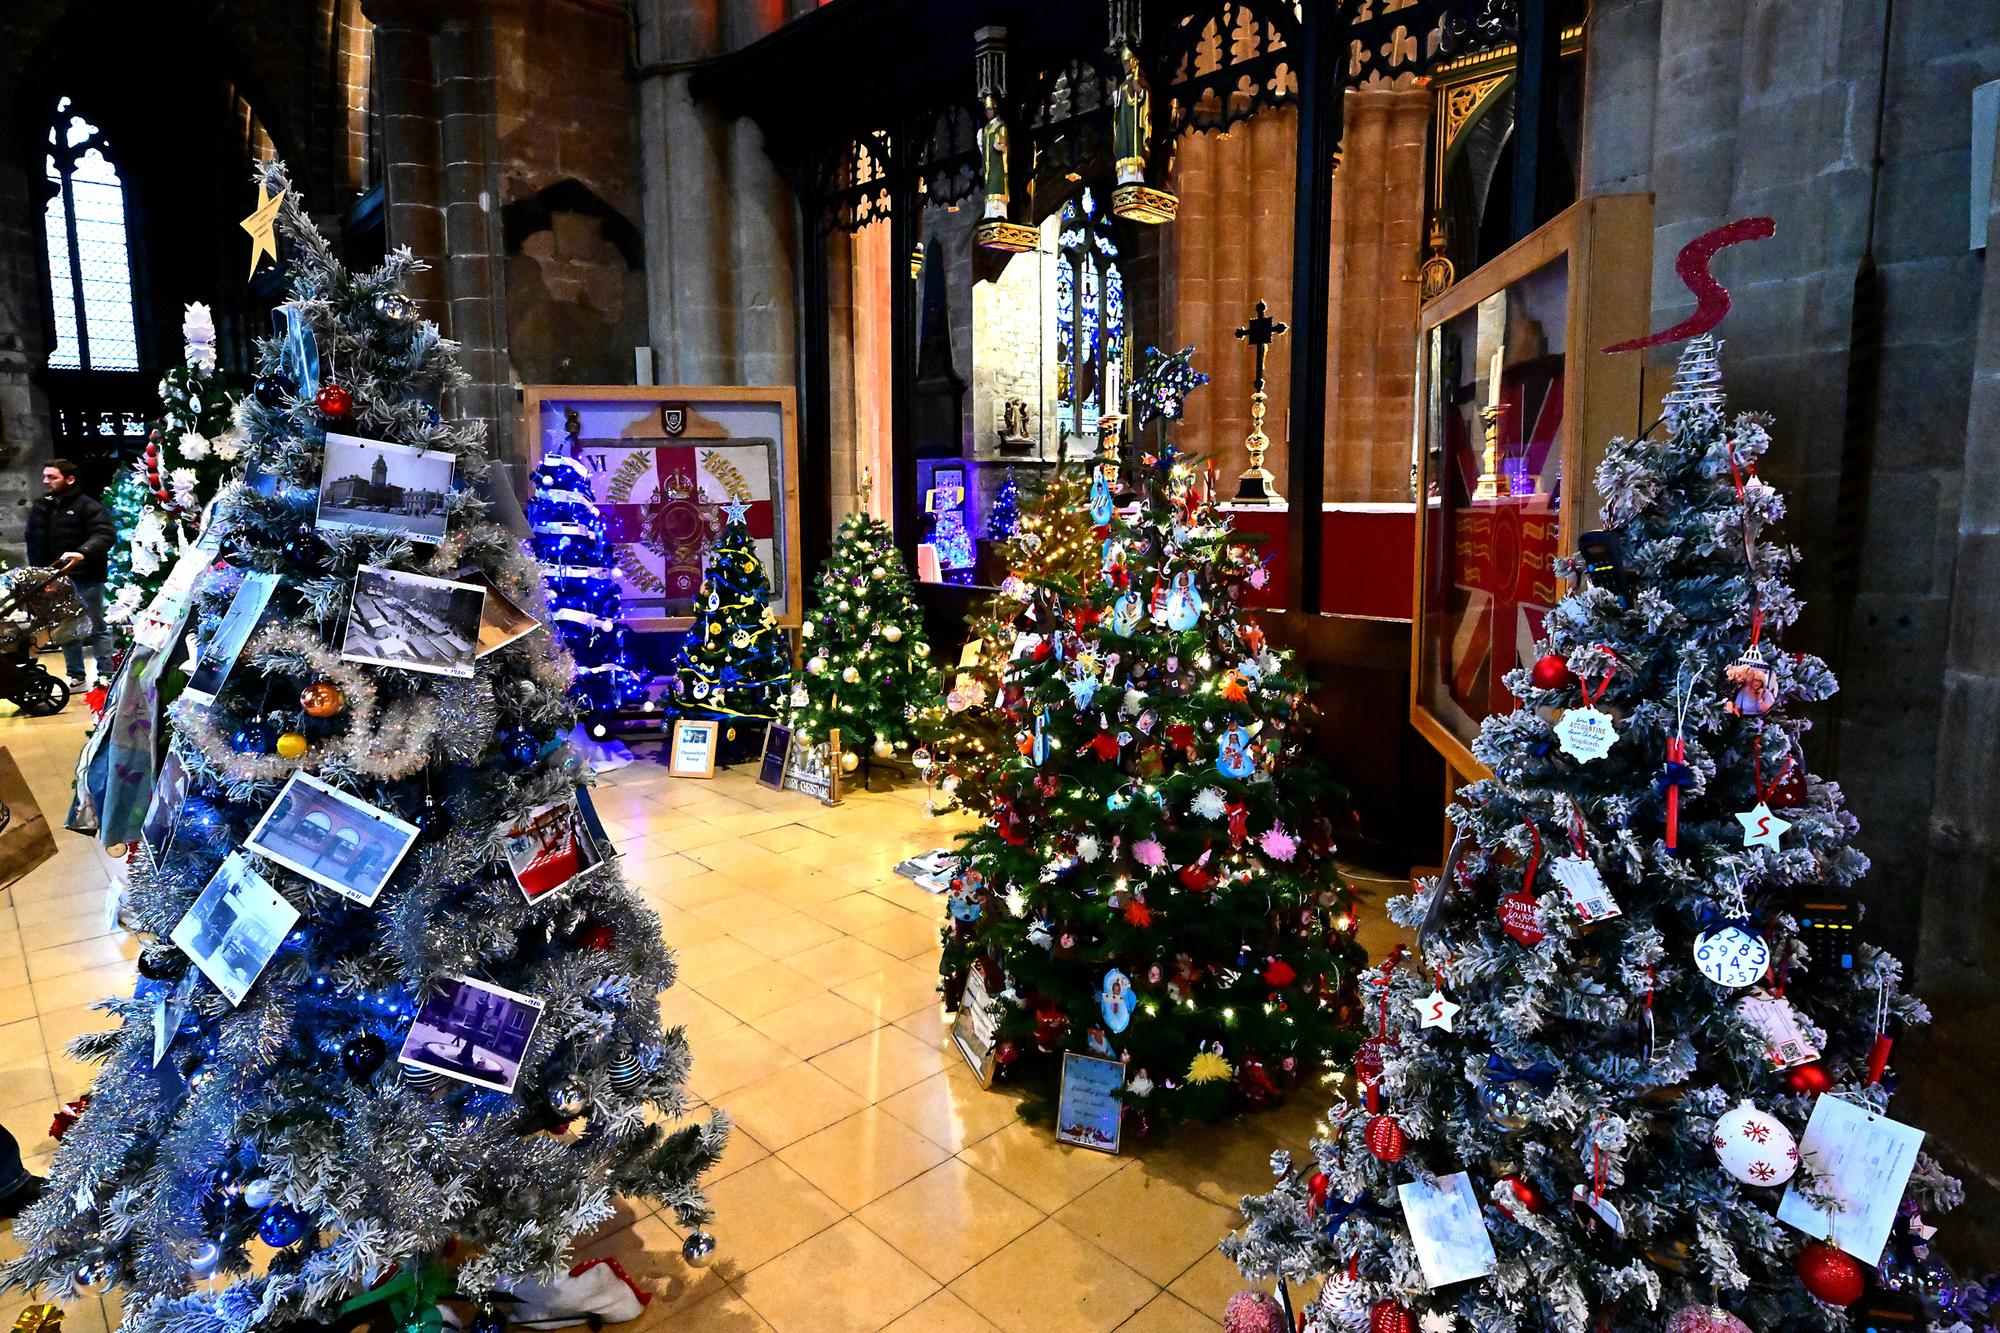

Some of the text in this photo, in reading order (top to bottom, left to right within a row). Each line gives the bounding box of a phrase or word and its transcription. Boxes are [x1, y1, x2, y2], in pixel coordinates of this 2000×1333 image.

[1600, 216, 1776, 354] S
[586, 455, 607, 471] VI
[1752, 816, 1771, 839] S
[1697, 943, 1767, 965] 6 9 8 3
[1730, 955, 1740, 969] 4
[1705, 962, 1759, 984] 4 1 2 5 7
[1429, 1001, 1444, 1021] S
